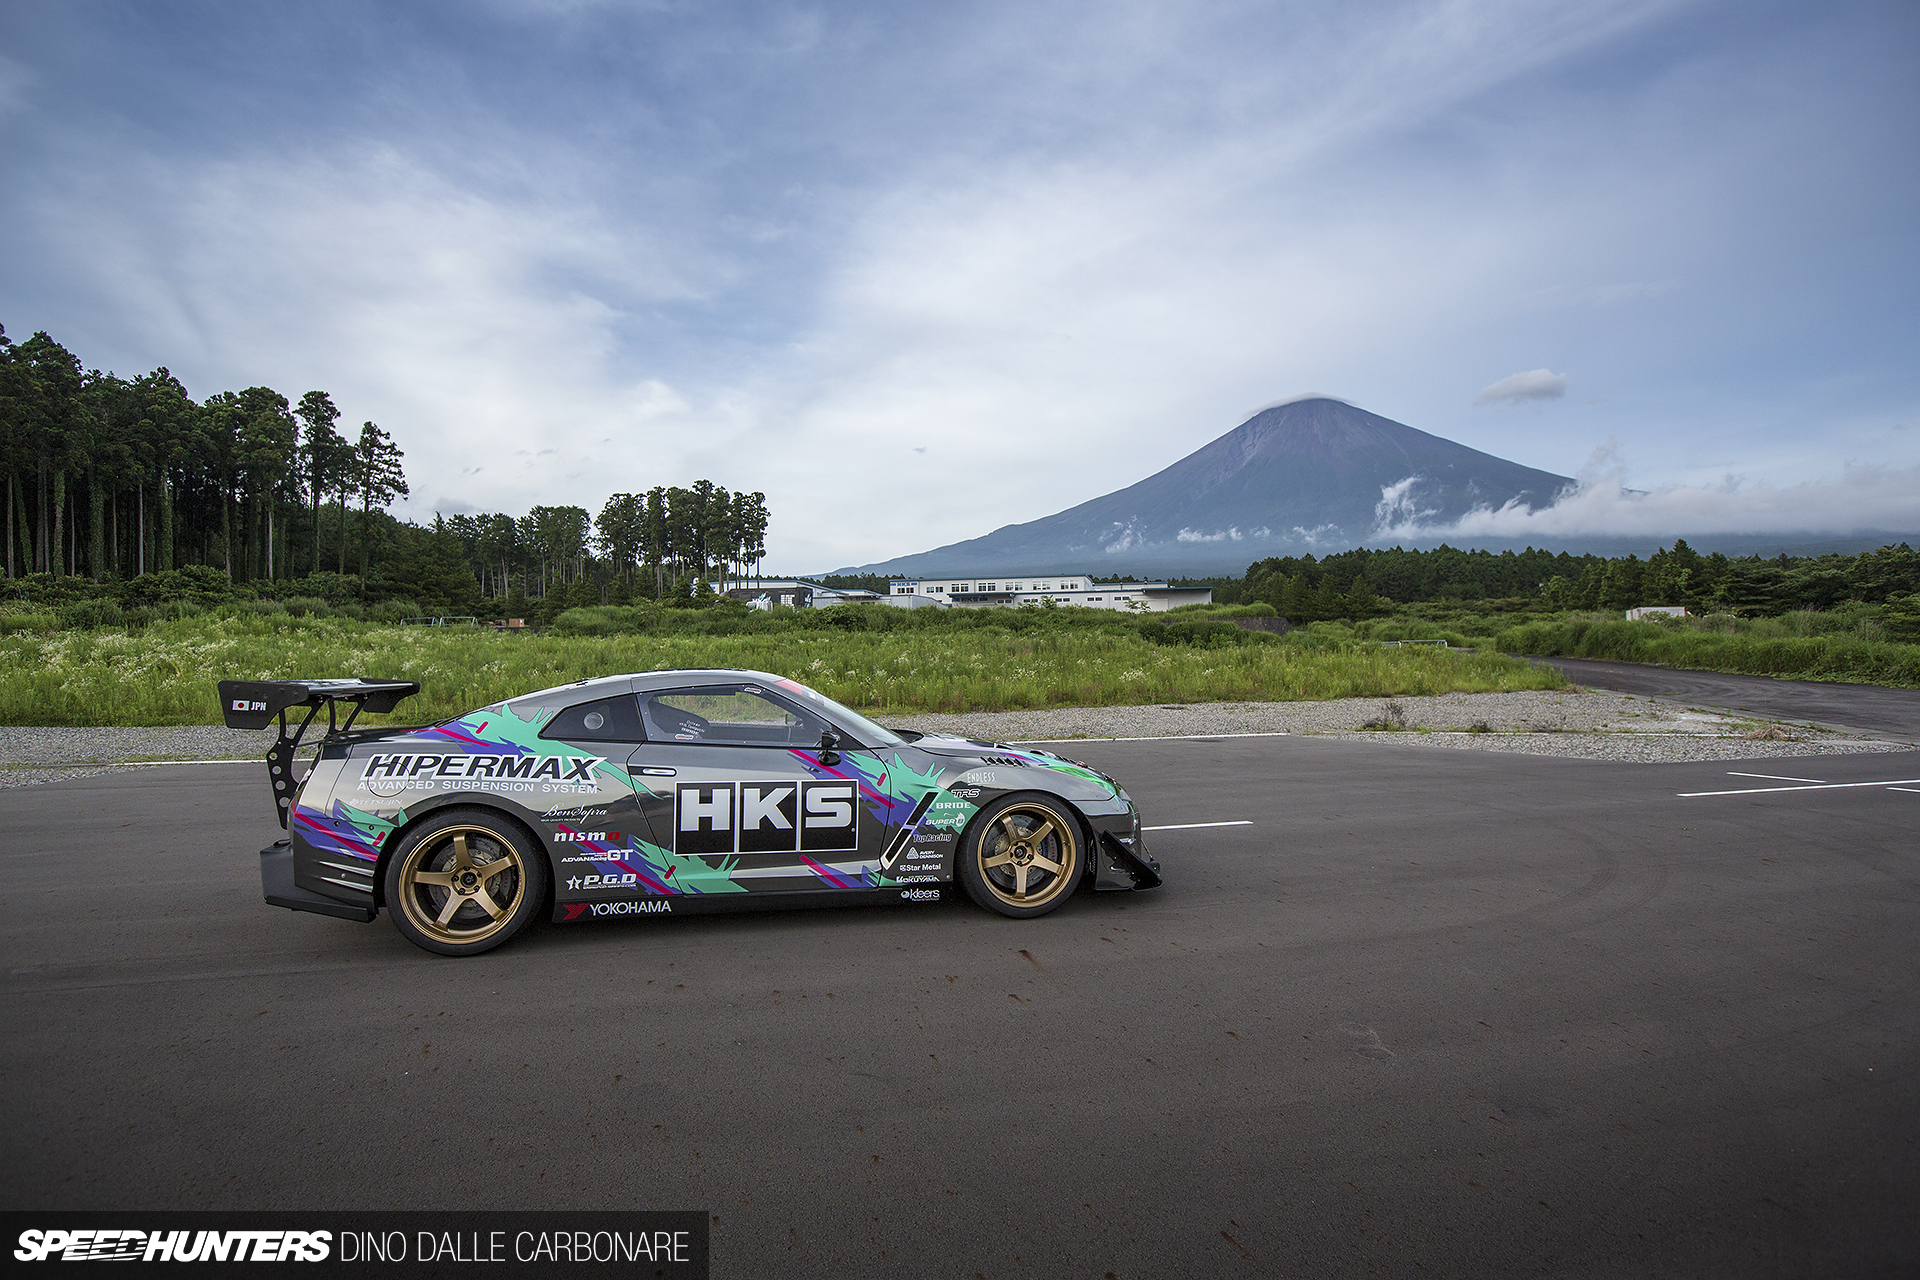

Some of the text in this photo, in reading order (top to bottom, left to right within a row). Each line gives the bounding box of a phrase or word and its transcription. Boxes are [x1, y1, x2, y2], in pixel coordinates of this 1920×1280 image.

[250, 701, 267, 711] JPN
[359, 753, 607, 785] HIPERMAX
[966, 772, 996, 784] ENDLESS
[357, 780, 598, 794] ADVANCED SUSPENSION SYSTEM
[951, 788, 981, 798] TRS
[680, 786, 853, 832] HKS
[935, 801, 971, 809] BRIDE
[925, 818, 955, 826] SUPER
[553, 831, 620, 842] nismo
[607, 849, 634, 860] GT
[906, 863, 942, 872] Star Metal
[583, 873, 637, 886] P.G.D
[910, 888, 940, 899] kleers
[589, 901, 672, 916] YOKOHAMA
